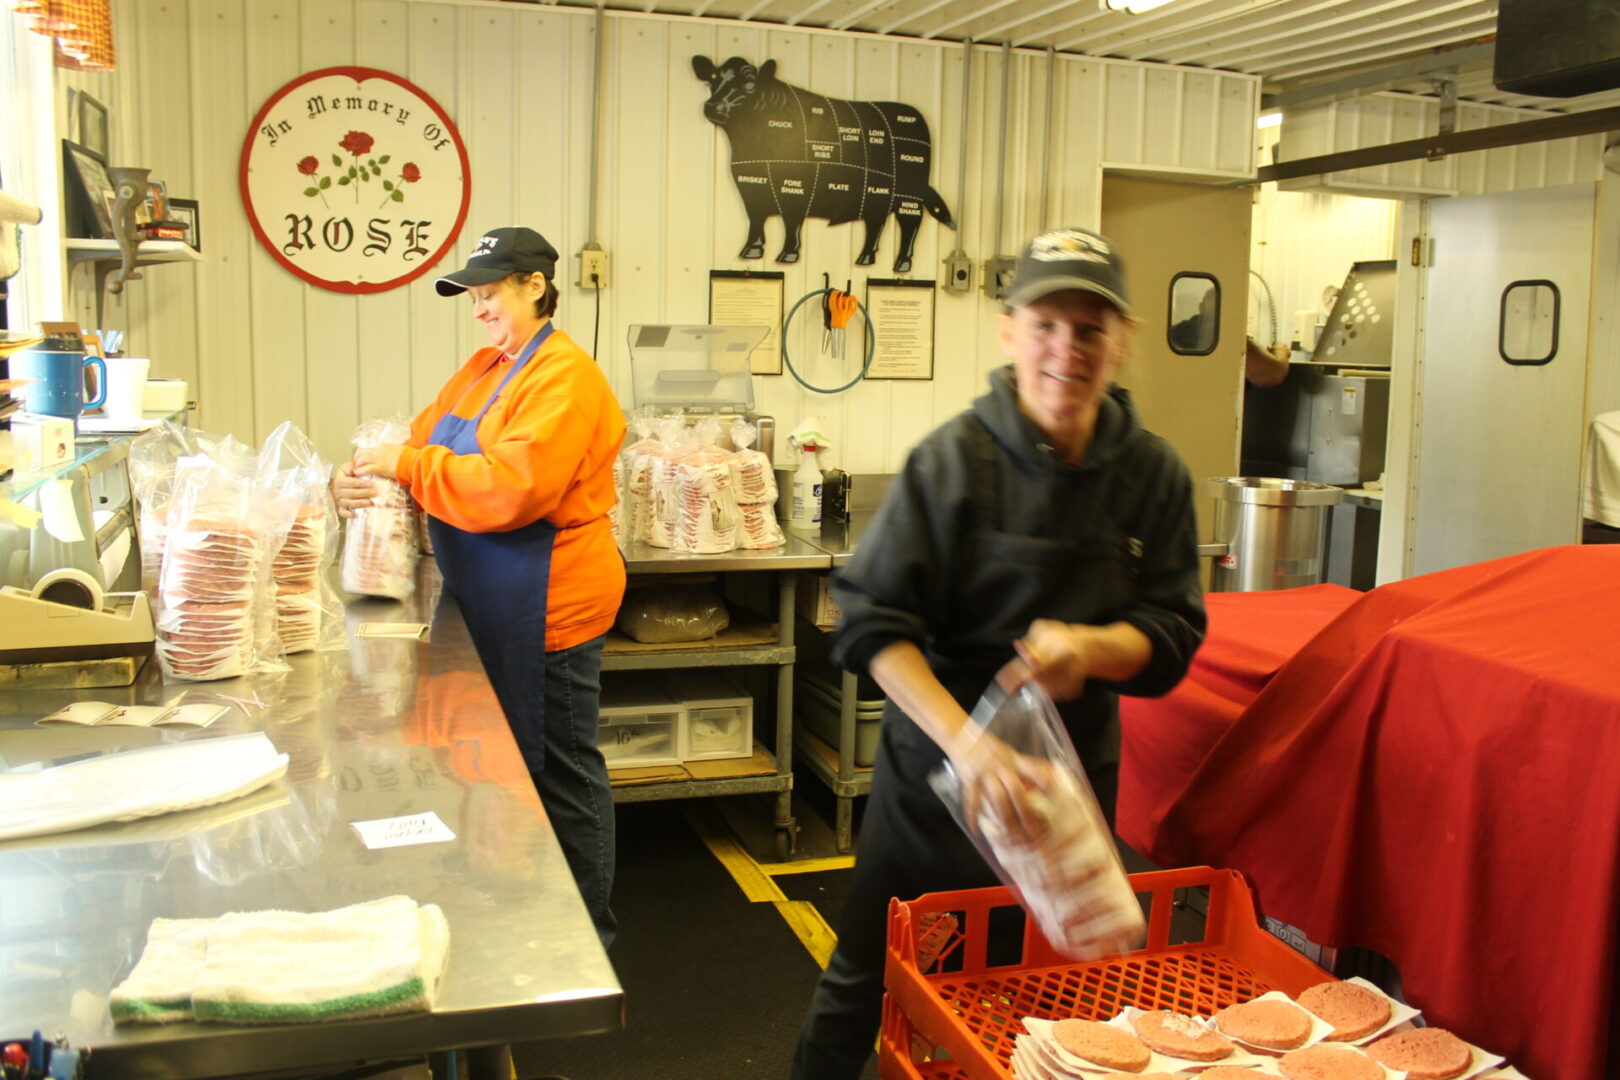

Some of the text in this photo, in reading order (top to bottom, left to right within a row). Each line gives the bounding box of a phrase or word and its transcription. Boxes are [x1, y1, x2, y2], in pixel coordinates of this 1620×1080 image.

[811, 107, 824, 115] RIB
[260, 95, 451, 151] In Memory Of
[897, 115, 917, 123] RUMP
[768, 120, 793, 129] CHUCK
[838, 126, 861, 135] SHORT
[868, 129, 885, 137] LOIN
[843, 134, 859, 142] LOIN
[869, 137, 884, 145] END
[811, 144, 834, 152] SHORT
[814, 151, 831, 159] RIBS
[900, 154, 925, 163] ROUND
[738, 175, 768, 184] BRISKET
[783, 179, 802, 188] FORE
[781, 186, 805, 195] SHANK
[828, 183, 849, 191] PLATE
[867, 186, 889, 194] FLANK
[901, 201, 919, 209] HIND
[899, 207, 921, 216] SHANK
[283, 213, 432, 261] ROSE
